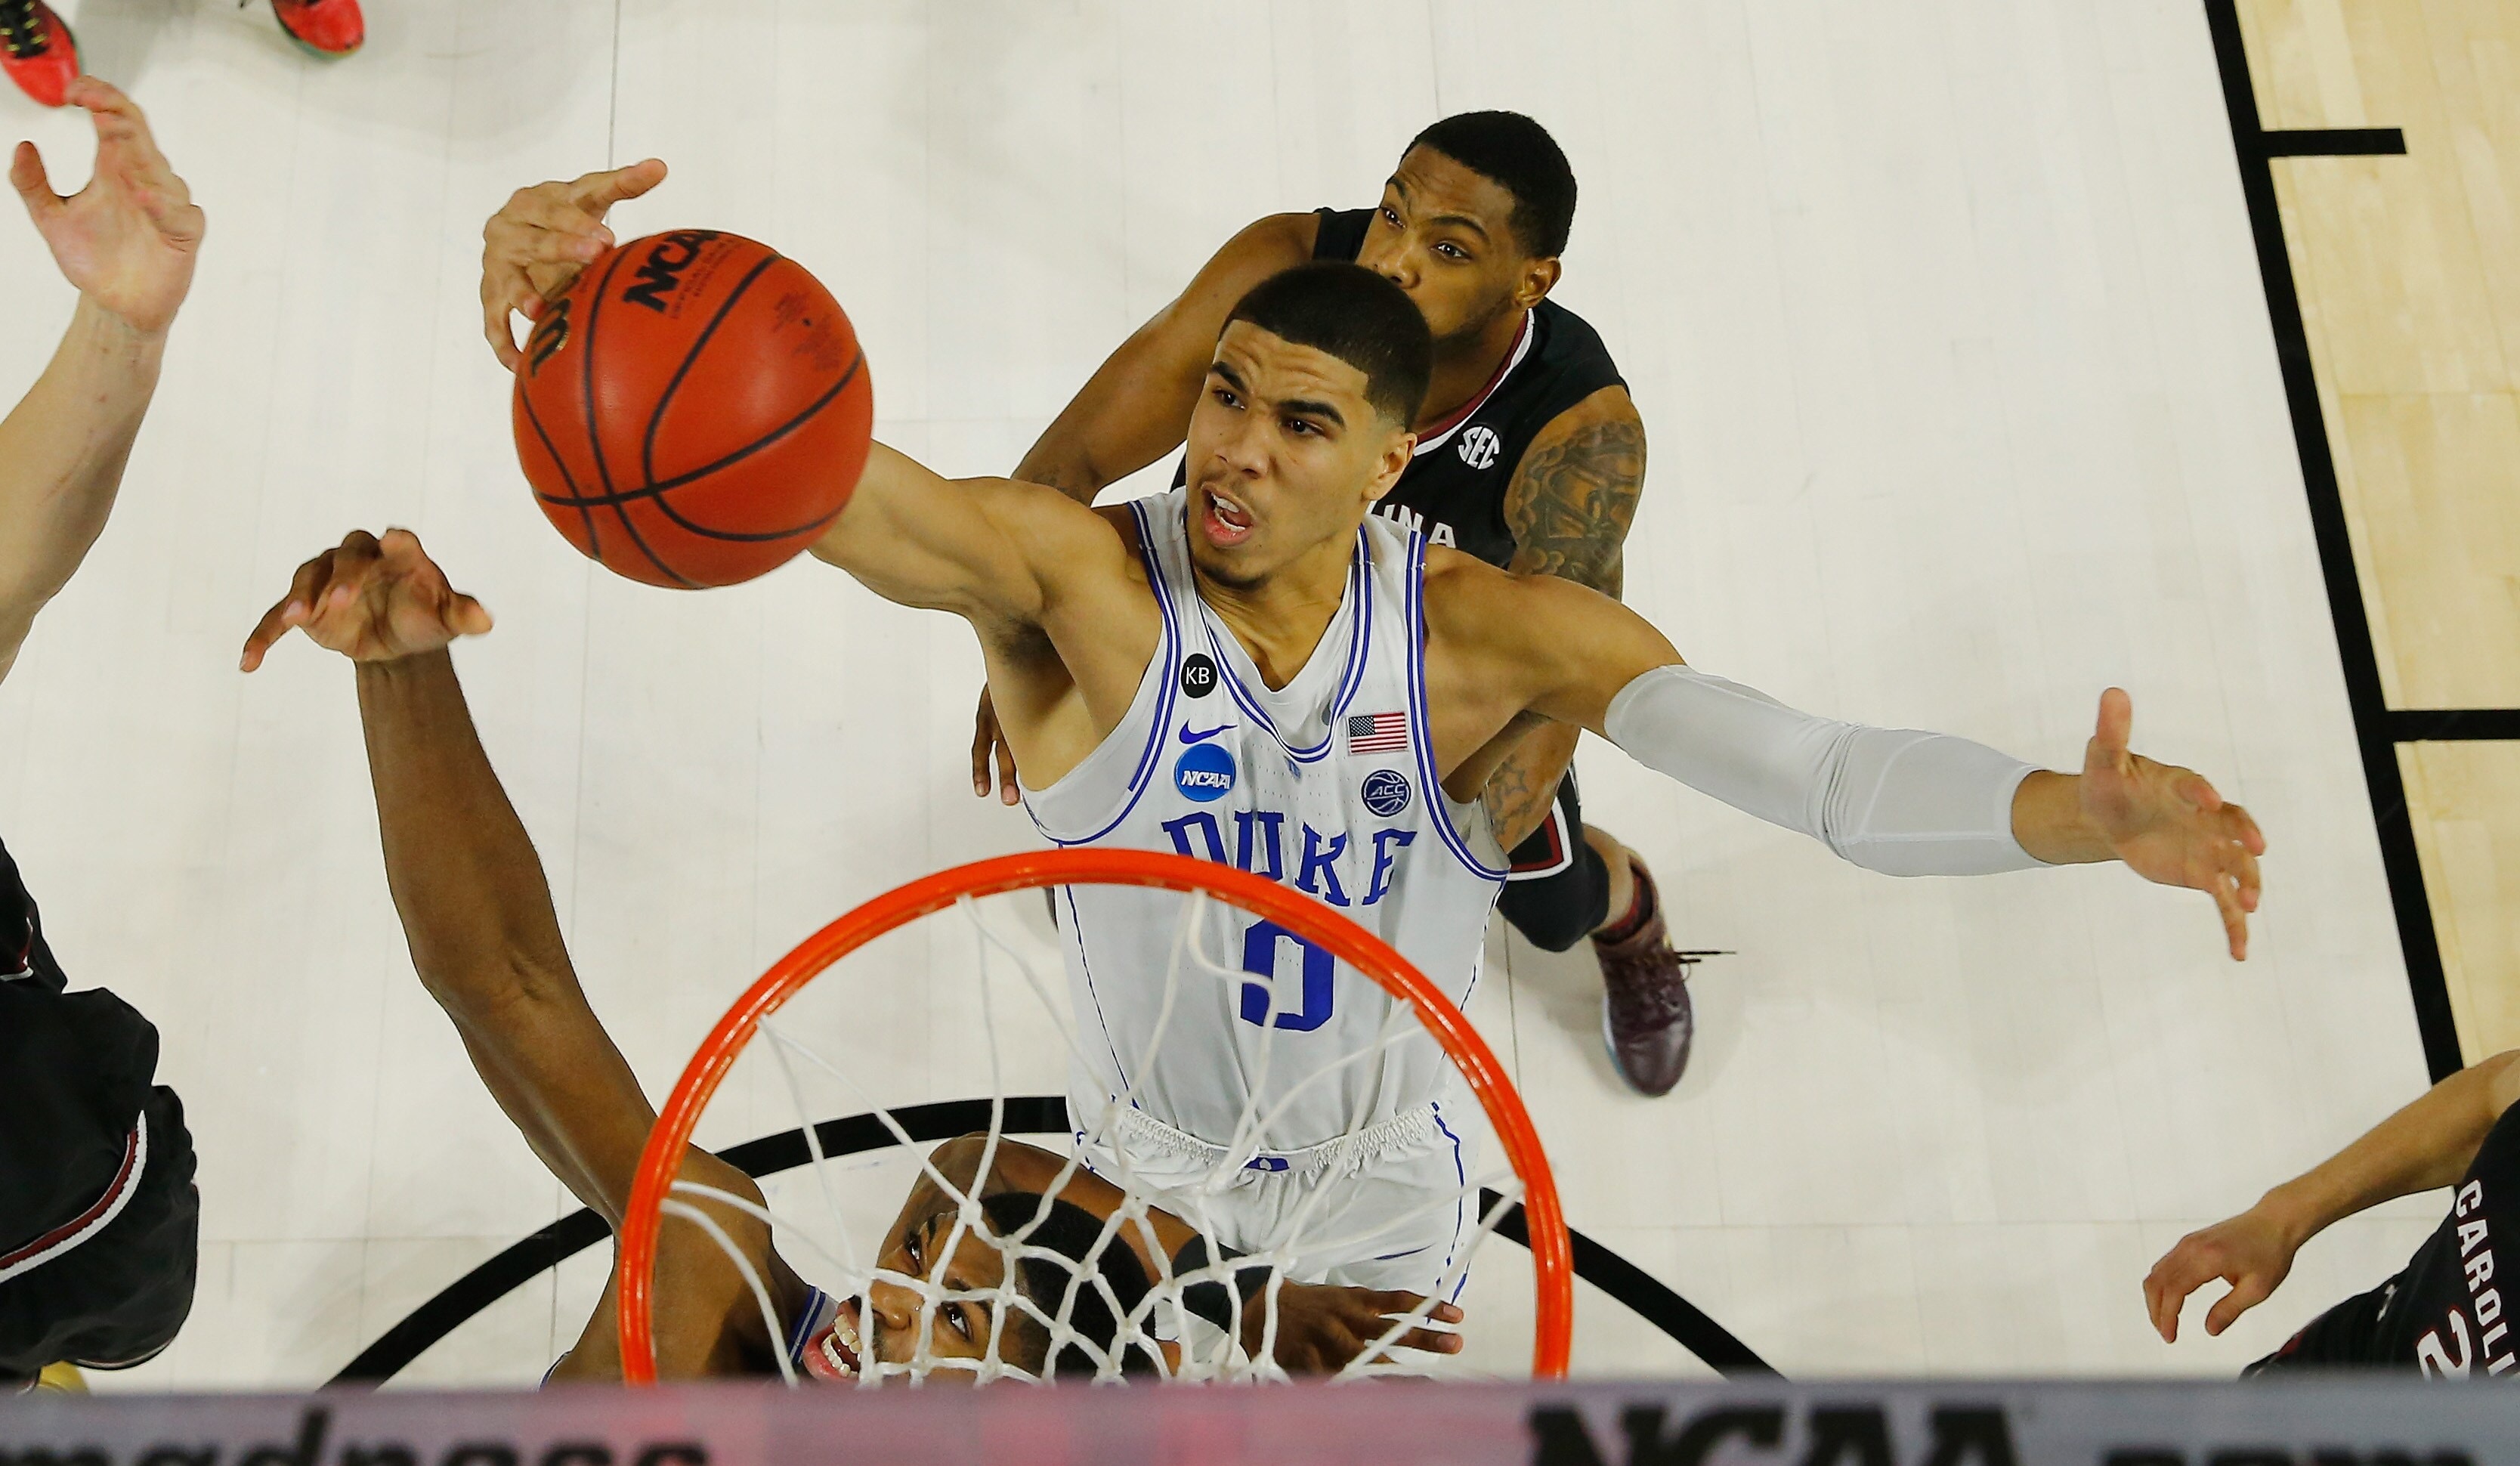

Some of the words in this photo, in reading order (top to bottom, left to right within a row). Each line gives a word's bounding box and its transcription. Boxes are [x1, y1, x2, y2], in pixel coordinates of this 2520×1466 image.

[623, 230, 719, 314] NCA
[1458, 425, 1501, 470] SEC
[1186, 667, 1211, 685] KB
[1181, 769, 1231, 790] NCAA
[1370, 783, 1405, 797] ACC
[1161, 810, 1418, 907] DUKE
[1240, 917, 1335, 1032] 0
[2456, 1179, 2520, 1378] CAROLI
